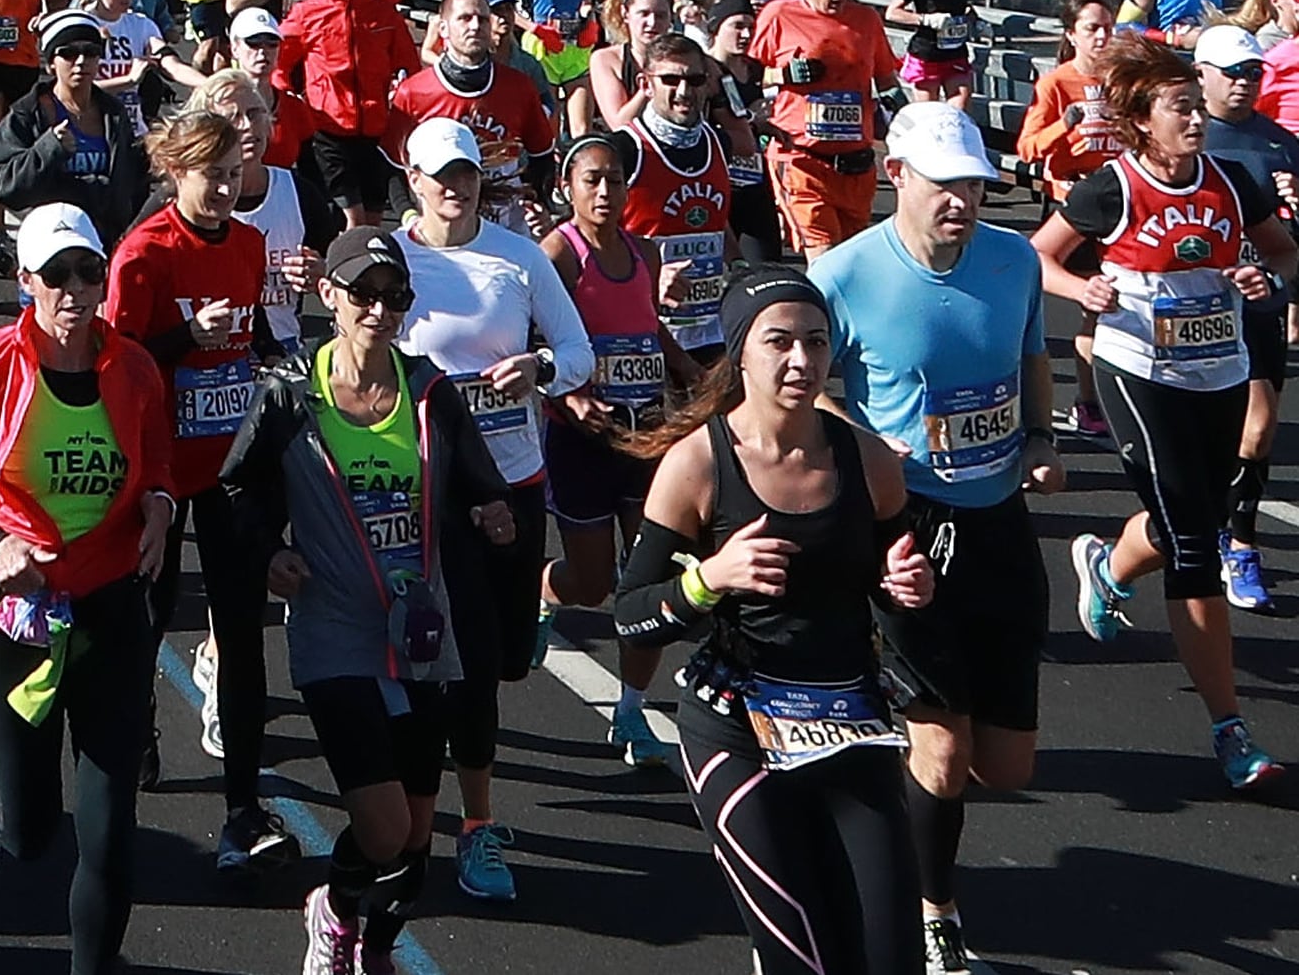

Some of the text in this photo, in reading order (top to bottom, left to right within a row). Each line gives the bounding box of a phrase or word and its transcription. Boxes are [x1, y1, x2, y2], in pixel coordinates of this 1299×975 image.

[663, 181, 724, 216] ITALIA
[1137, 204, 1232, 248] ITALIA
[1178, 316, 1234, 343] 48696
[612, 356, 663, 383] 43380
[203, 385, 250, 417] 20192
[44, 450, 127, 474] TEAM
[59, 475, 124, 498] KIDS
[346, 473, 414, 493] EAM
[786, 691, 810, 702] TATA
